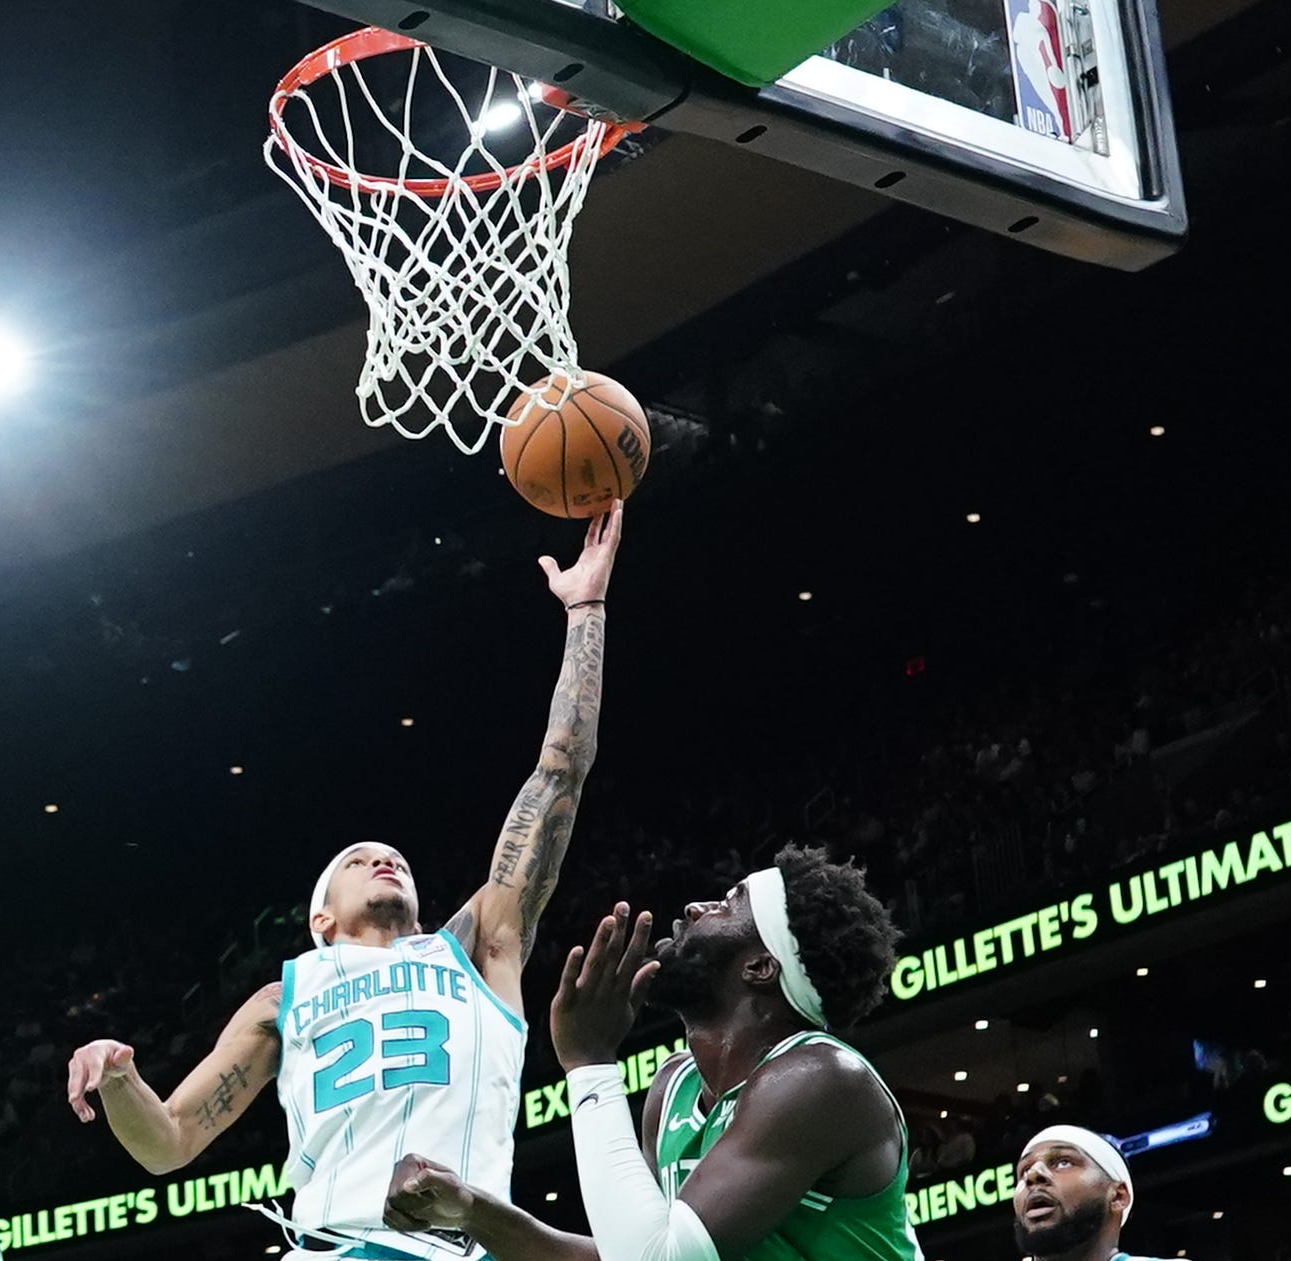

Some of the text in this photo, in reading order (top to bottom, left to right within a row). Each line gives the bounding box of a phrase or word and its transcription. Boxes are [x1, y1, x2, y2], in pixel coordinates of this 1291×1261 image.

[292, 961, 467, 1036] CHARLOTTE
[890, 892, 1099, 1001] GILLETTE'S
[312, 1008, 451, 1114] 23
